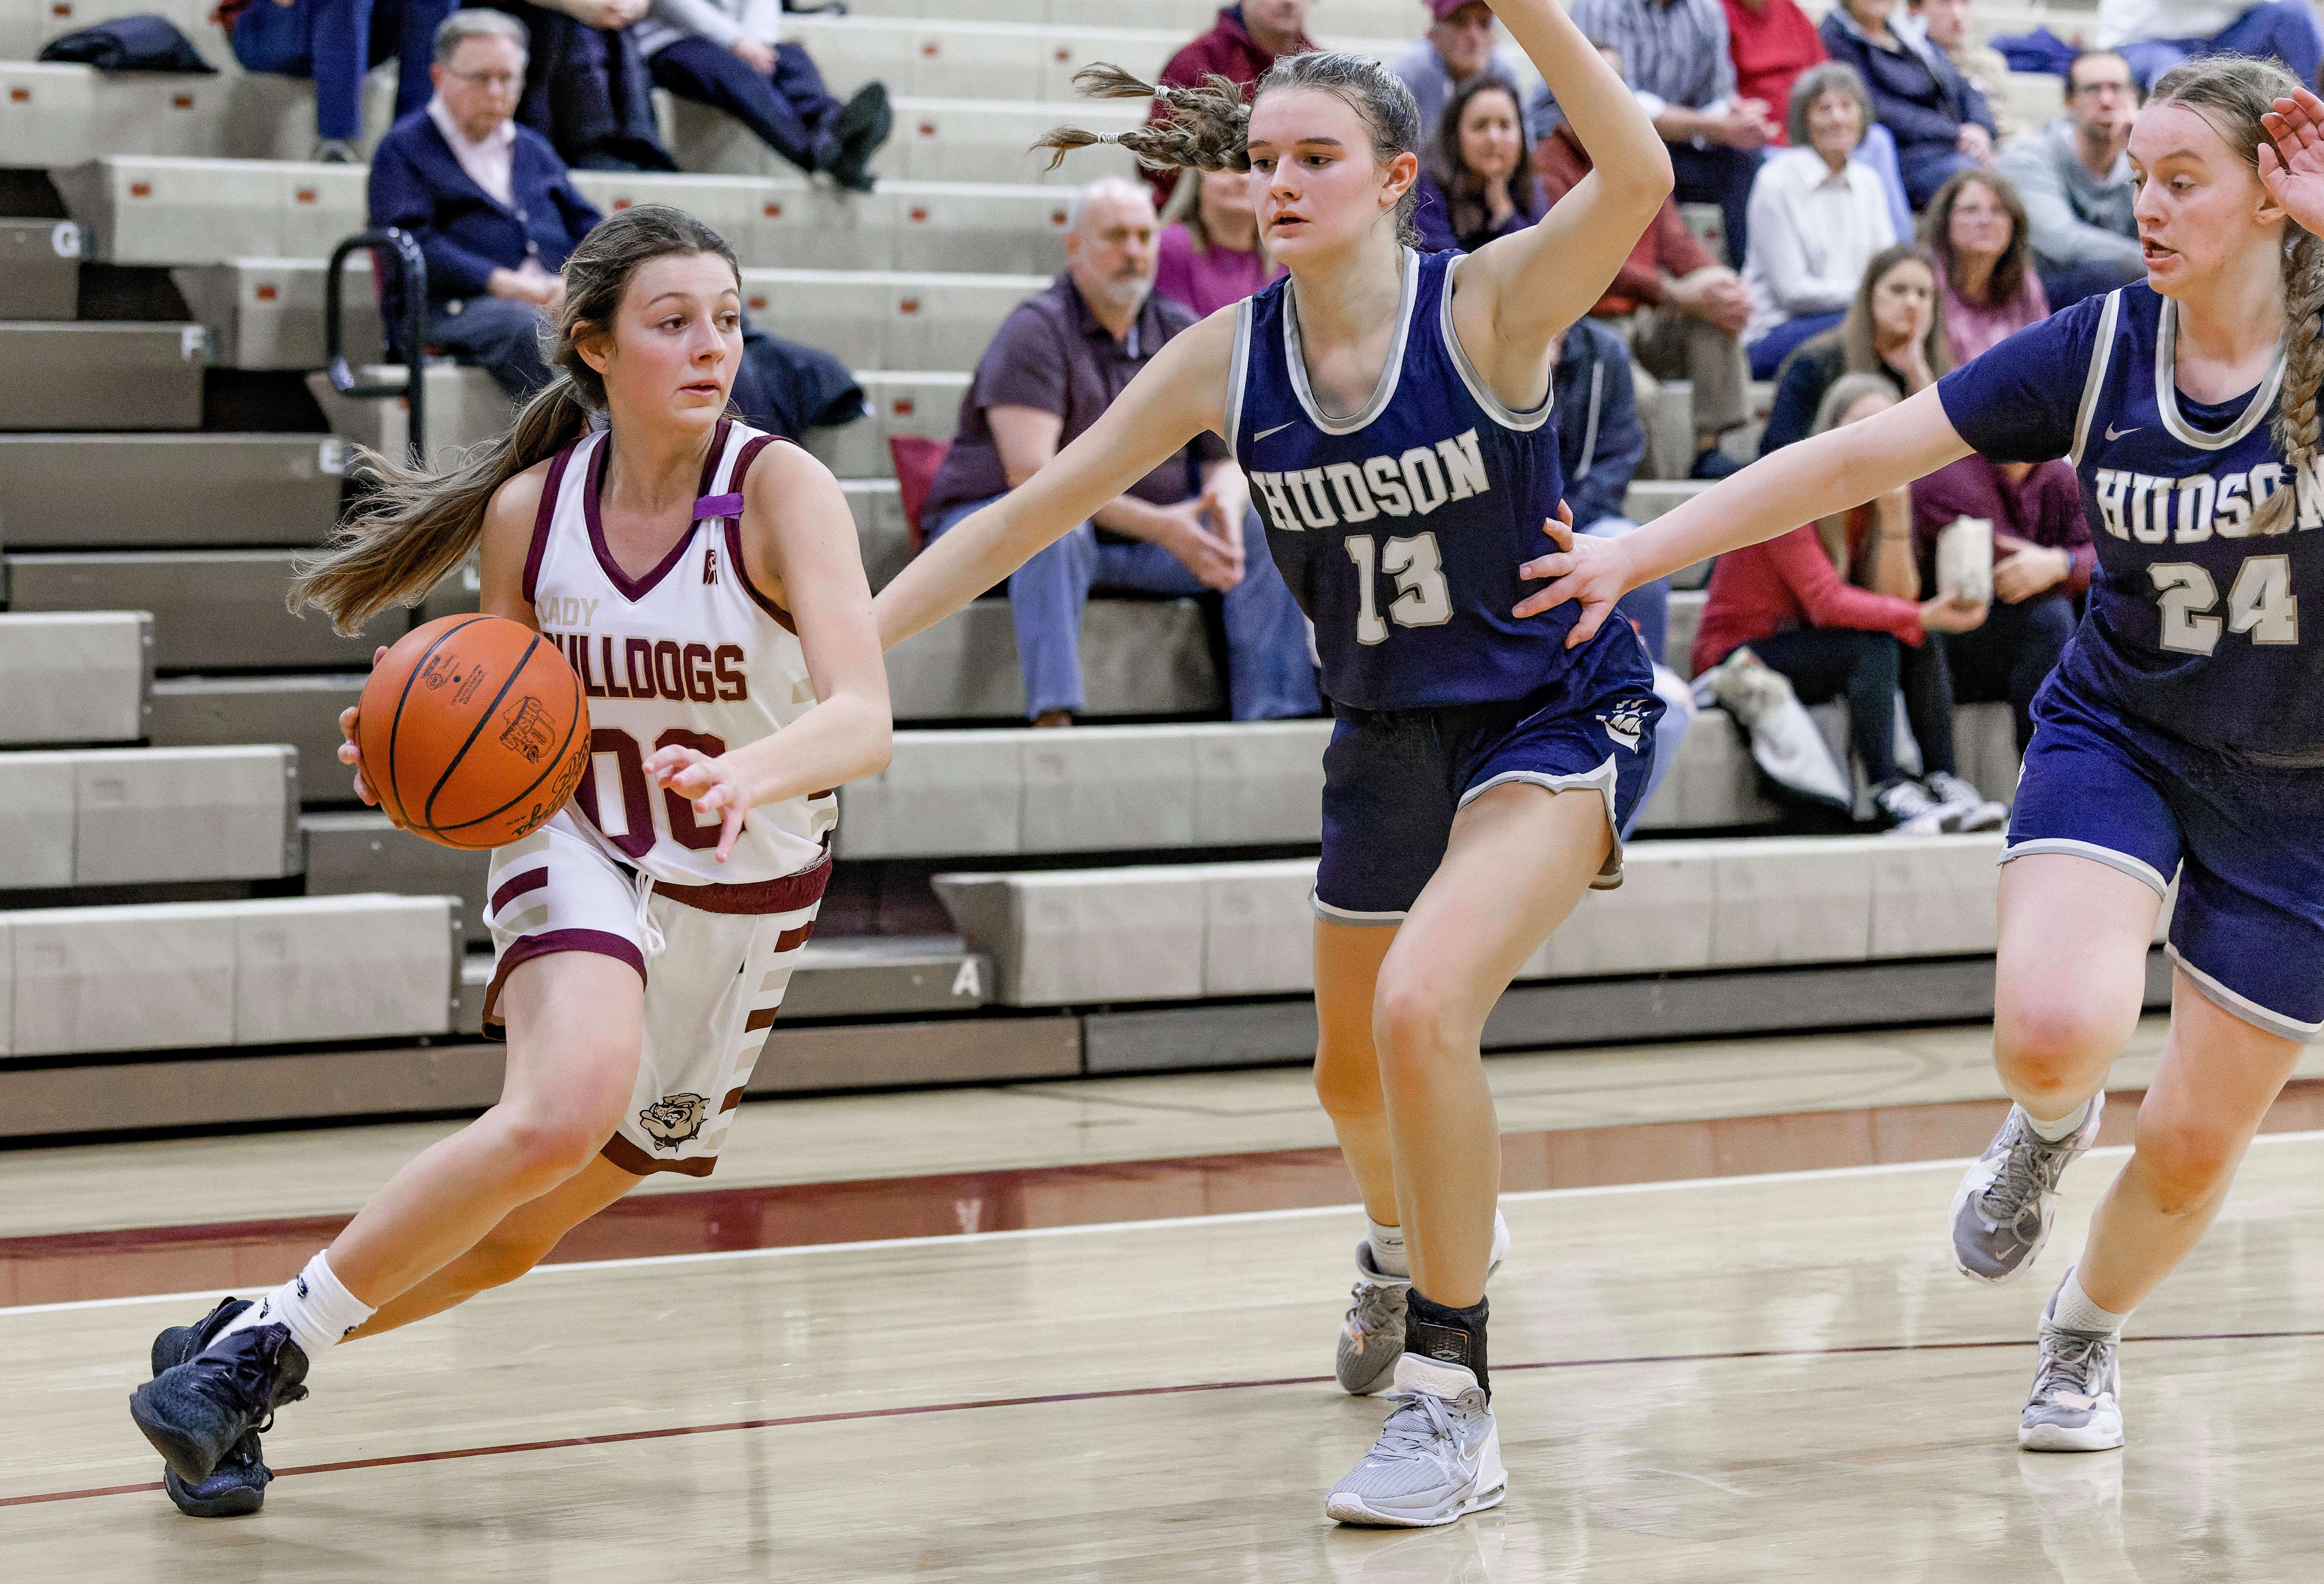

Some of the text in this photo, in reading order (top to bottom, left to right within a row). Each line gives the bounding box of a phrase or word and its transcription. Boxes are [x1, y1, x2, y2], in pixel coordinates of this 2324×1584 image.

[1250, 427, 1490, 531] HUDSON
[1344, 531, 1454, 645] 13
[2147, 554, 2299, 656] 24
[543, 631, 749, 704] LLDOGS
[952, 957, 981, 996] A
